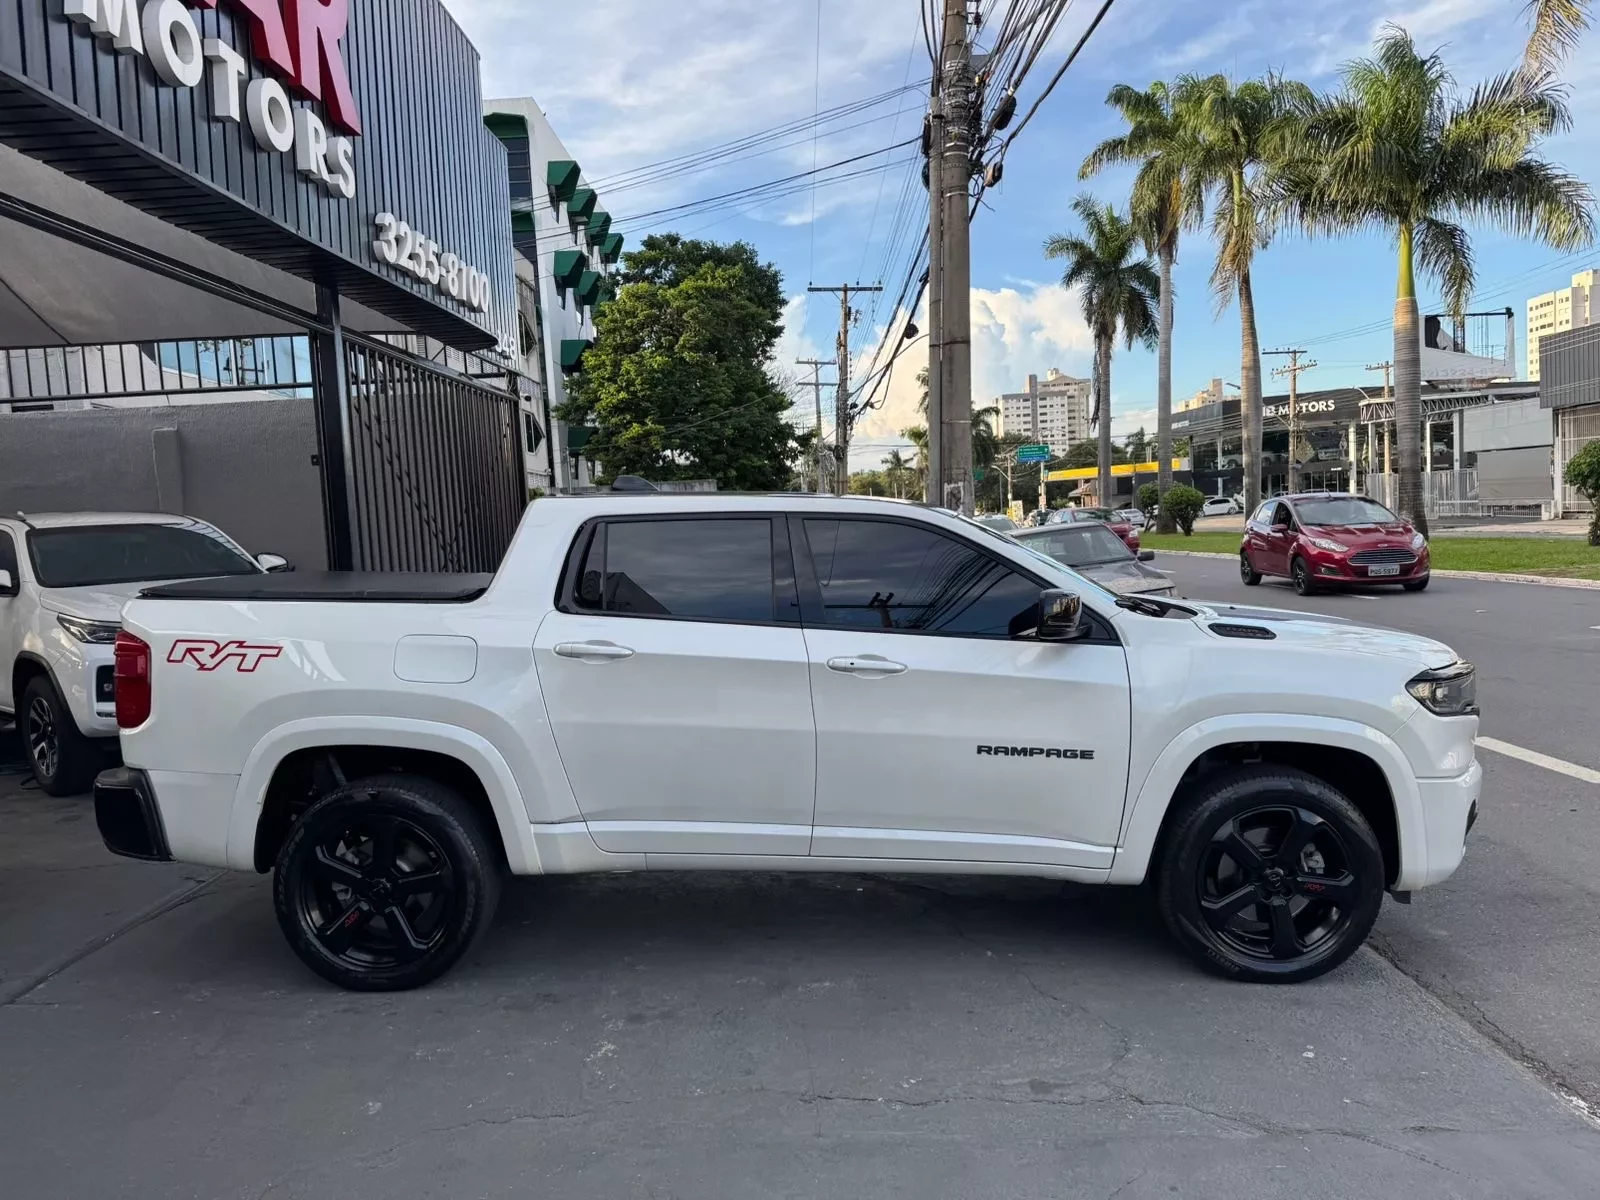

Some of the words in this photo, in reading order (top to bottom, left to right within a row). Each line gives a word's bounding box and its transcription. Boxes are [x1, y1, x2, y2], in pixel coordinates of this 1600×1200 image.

[373, 212, 489, 313] 3255-8100
[166, 639, 283, 672] R/T
[976, 745, 1095, 760] RAMPAGE
